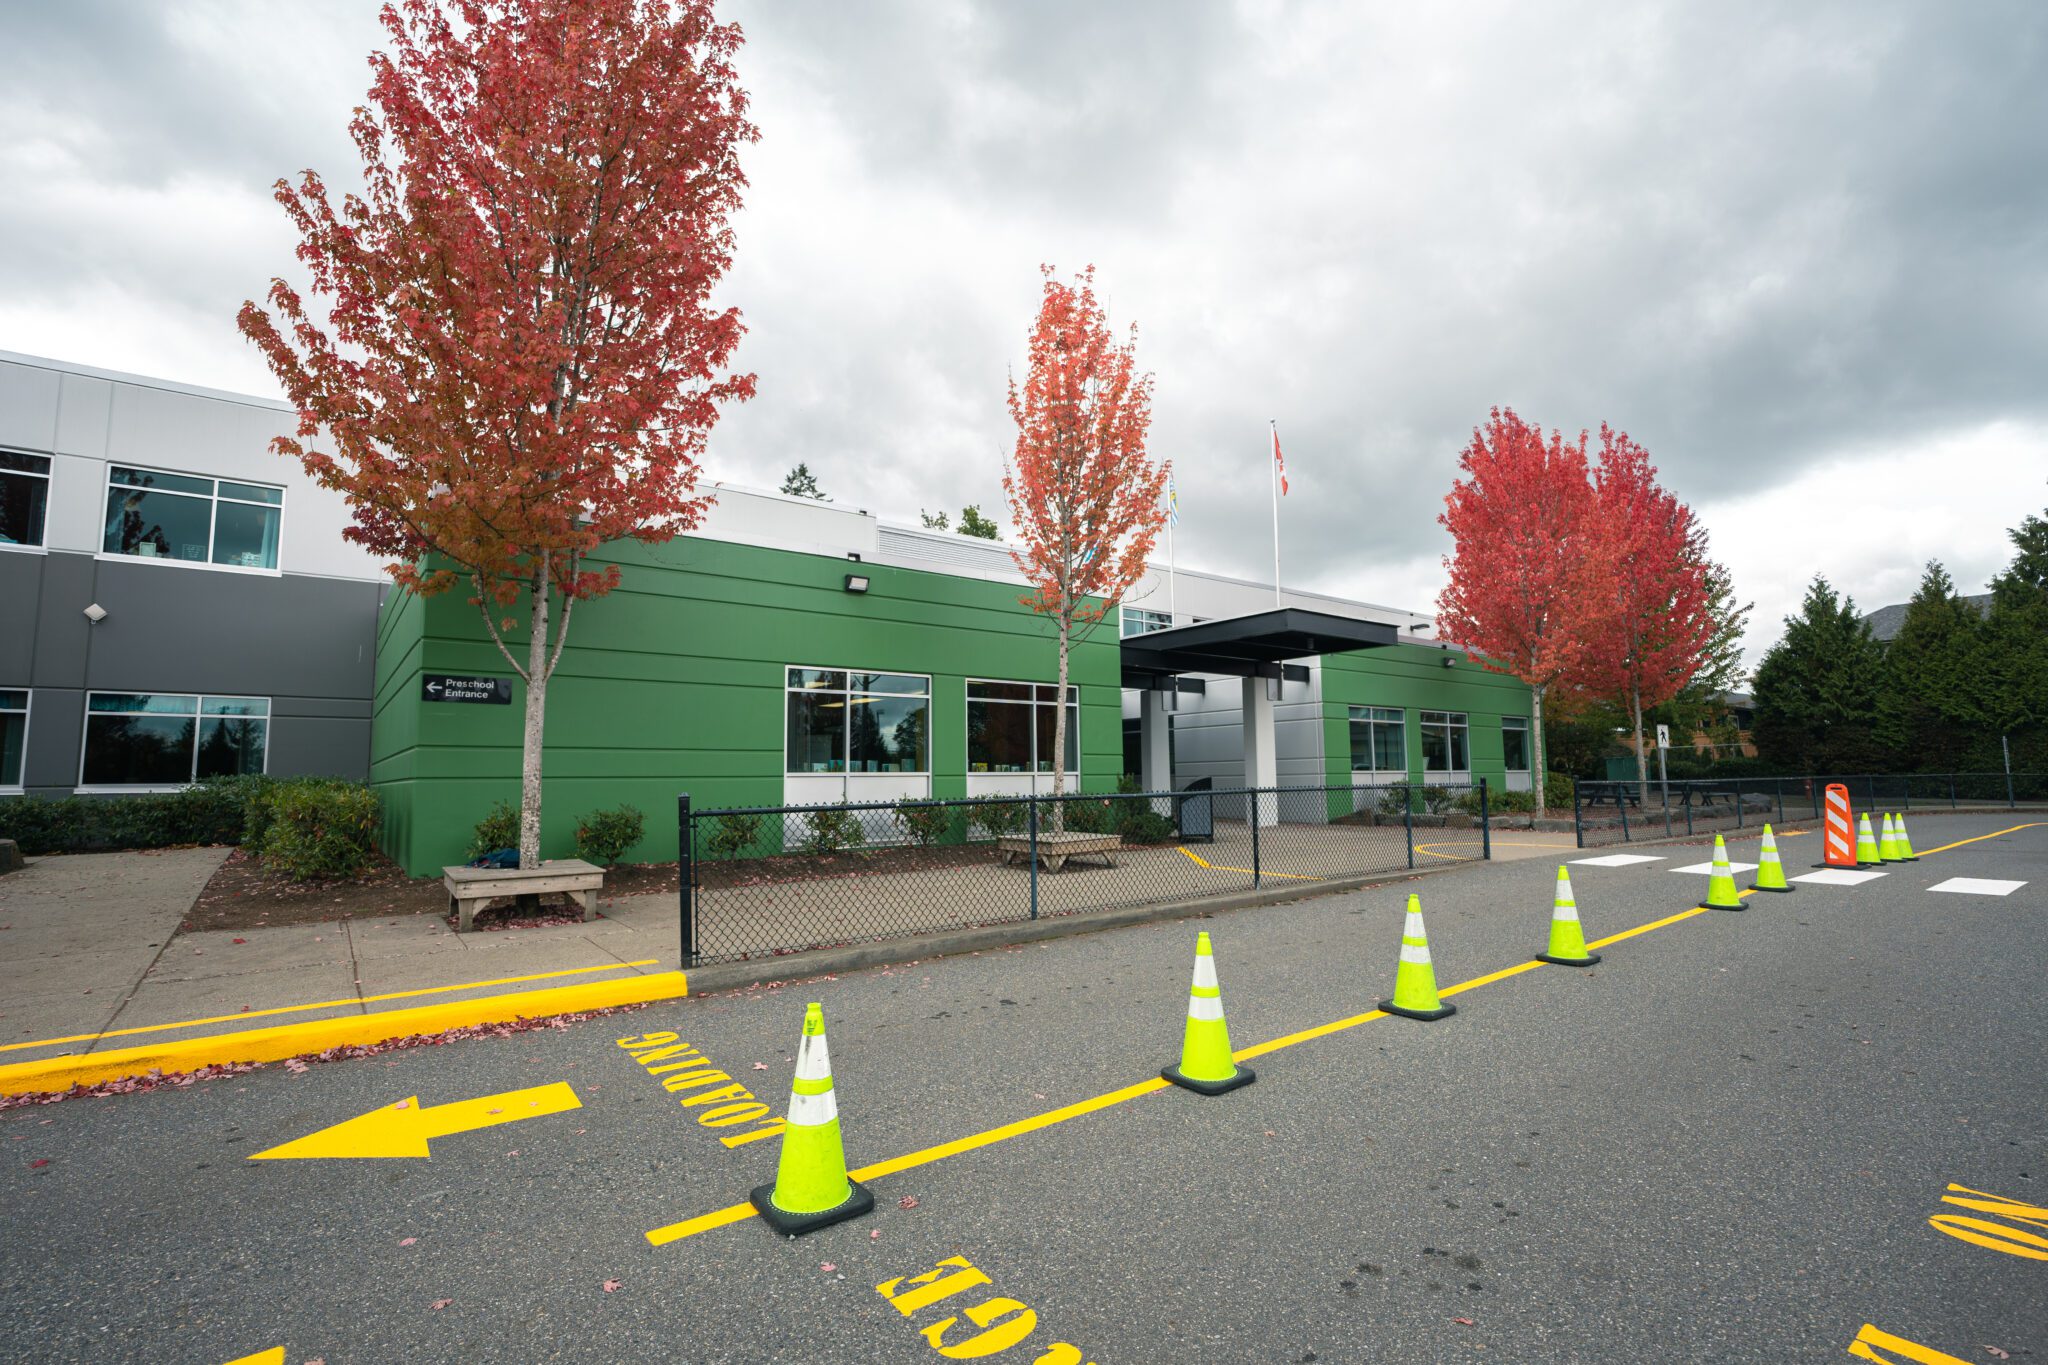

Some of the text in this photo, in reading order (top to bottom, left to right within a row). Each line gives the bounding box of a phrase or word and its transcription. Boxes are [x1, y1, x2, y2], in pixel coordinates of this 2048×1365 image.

[445, 679, 495, 689] Preschool
[445, 689, 489, 699] Entrance
[616, 1031, 788, 1149] LOADING
